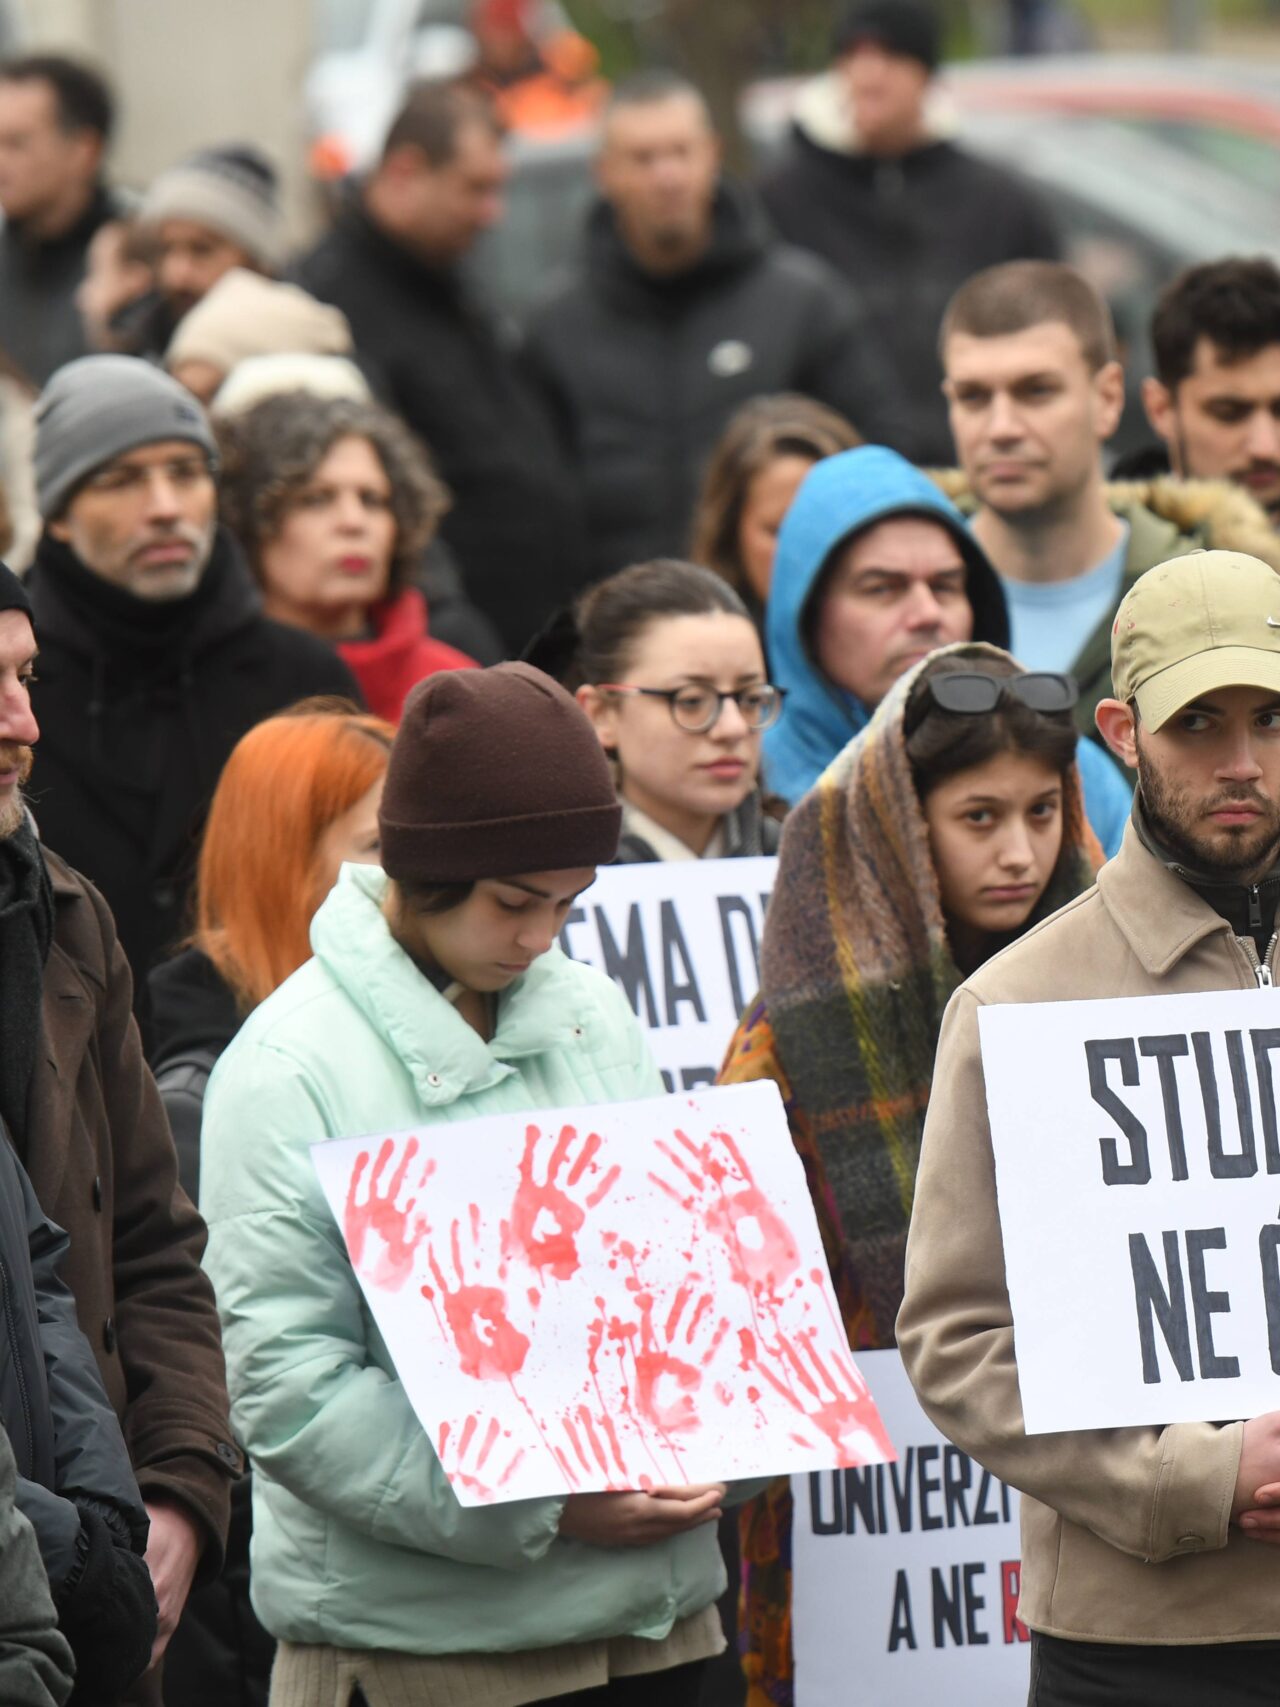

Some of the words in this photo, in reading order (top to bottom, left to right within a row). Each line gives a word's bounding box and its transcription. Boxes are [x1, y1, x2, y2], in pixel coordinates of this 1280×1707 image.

[1128, 1226, 1241, 1385] NE
[887, 1569, 918, 1653] A
[931, 1561, 990, 1649] NE
